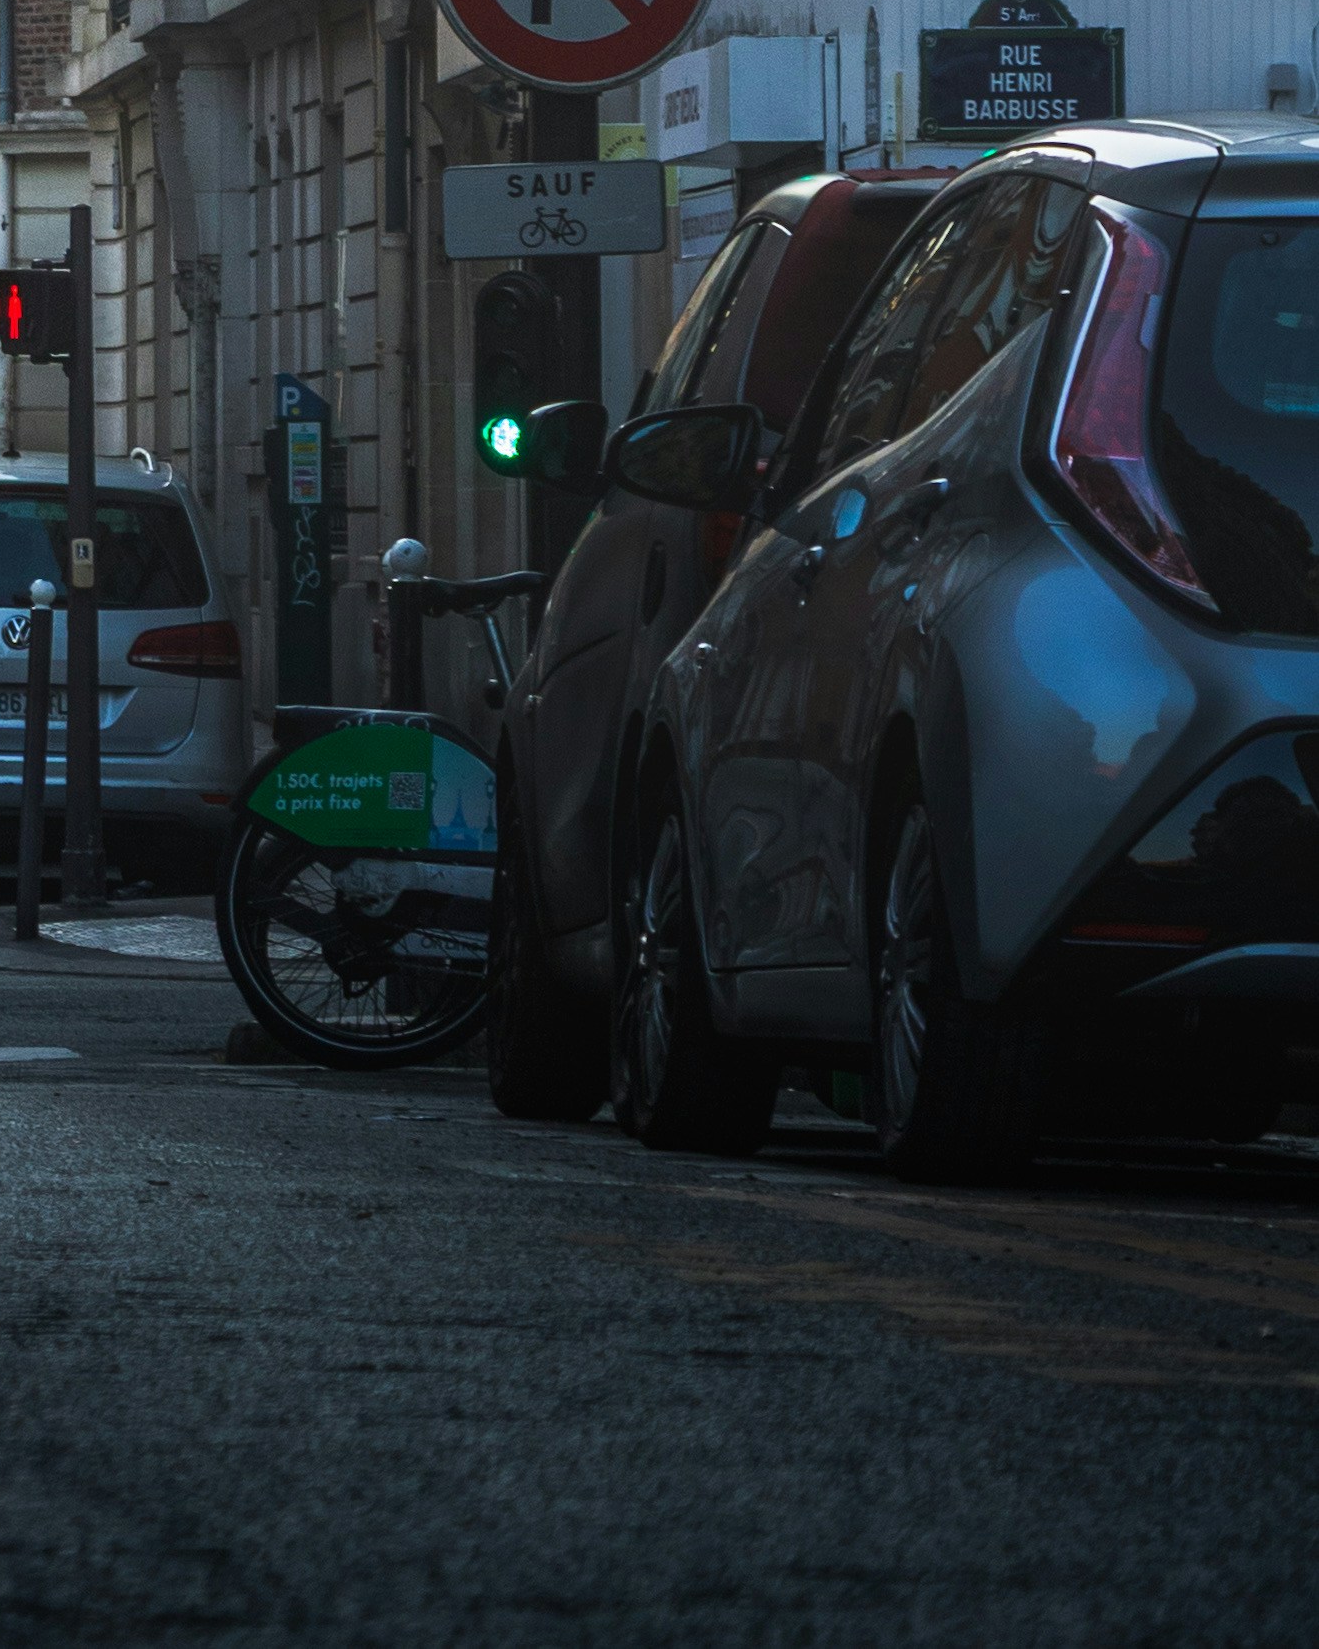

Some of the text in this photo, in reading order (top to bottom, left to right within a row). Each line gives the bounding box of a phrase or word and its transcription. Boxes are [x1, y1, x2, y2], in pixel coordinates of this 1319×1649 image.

[999, 45, 1042, 66] RUE
[990, 72, 1053, 93] HENRI
[964, 99, 1079, 121] BARBUSSE
[507, 171, 596, 198] SAUF
[328, 772, 383, 792] trajets
[291, 795, 324, 815] prix
[328, 793, 361, 810] fixe
